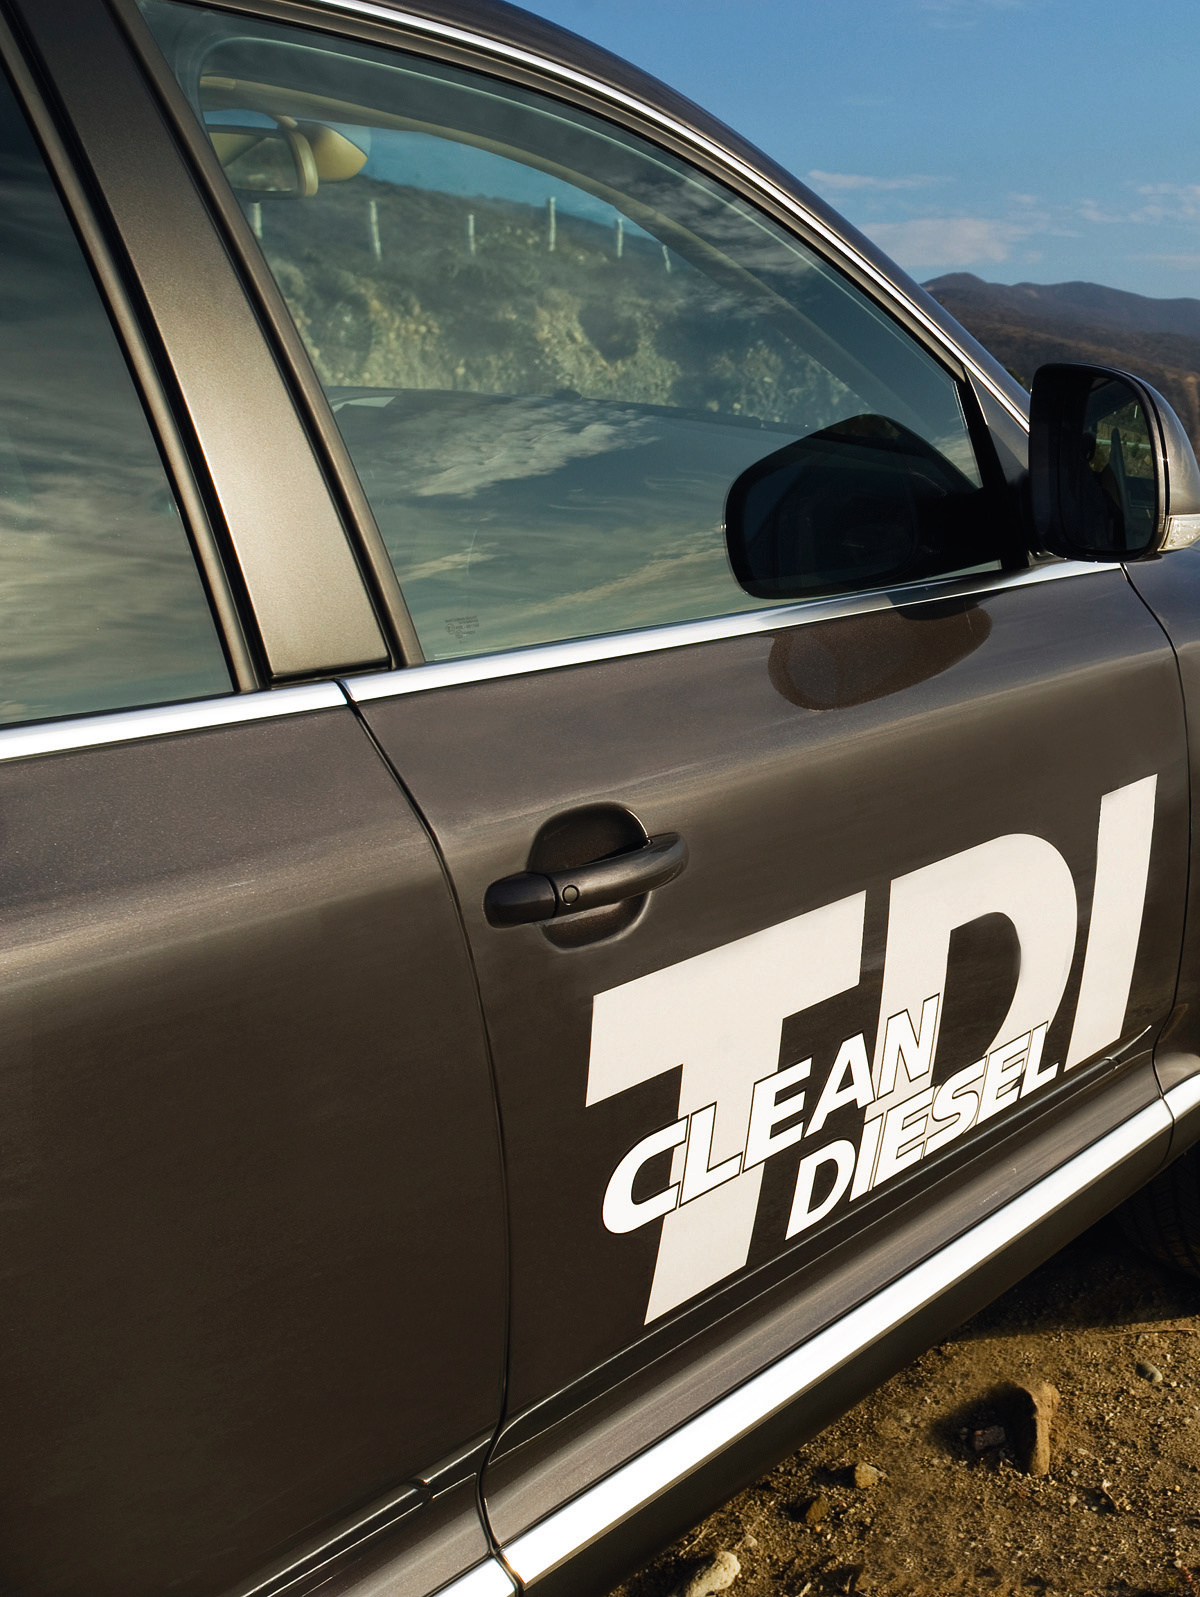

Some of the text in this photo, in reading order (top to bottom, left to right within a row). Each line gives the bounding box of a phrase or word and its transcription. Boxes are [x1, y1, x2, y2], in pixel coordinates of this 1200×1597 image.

[585, 774, 1158, 1325] TDI
[602, 993, 940, 1234] CLEAN
[785, 1021, 1059, 1240] DIESEL
